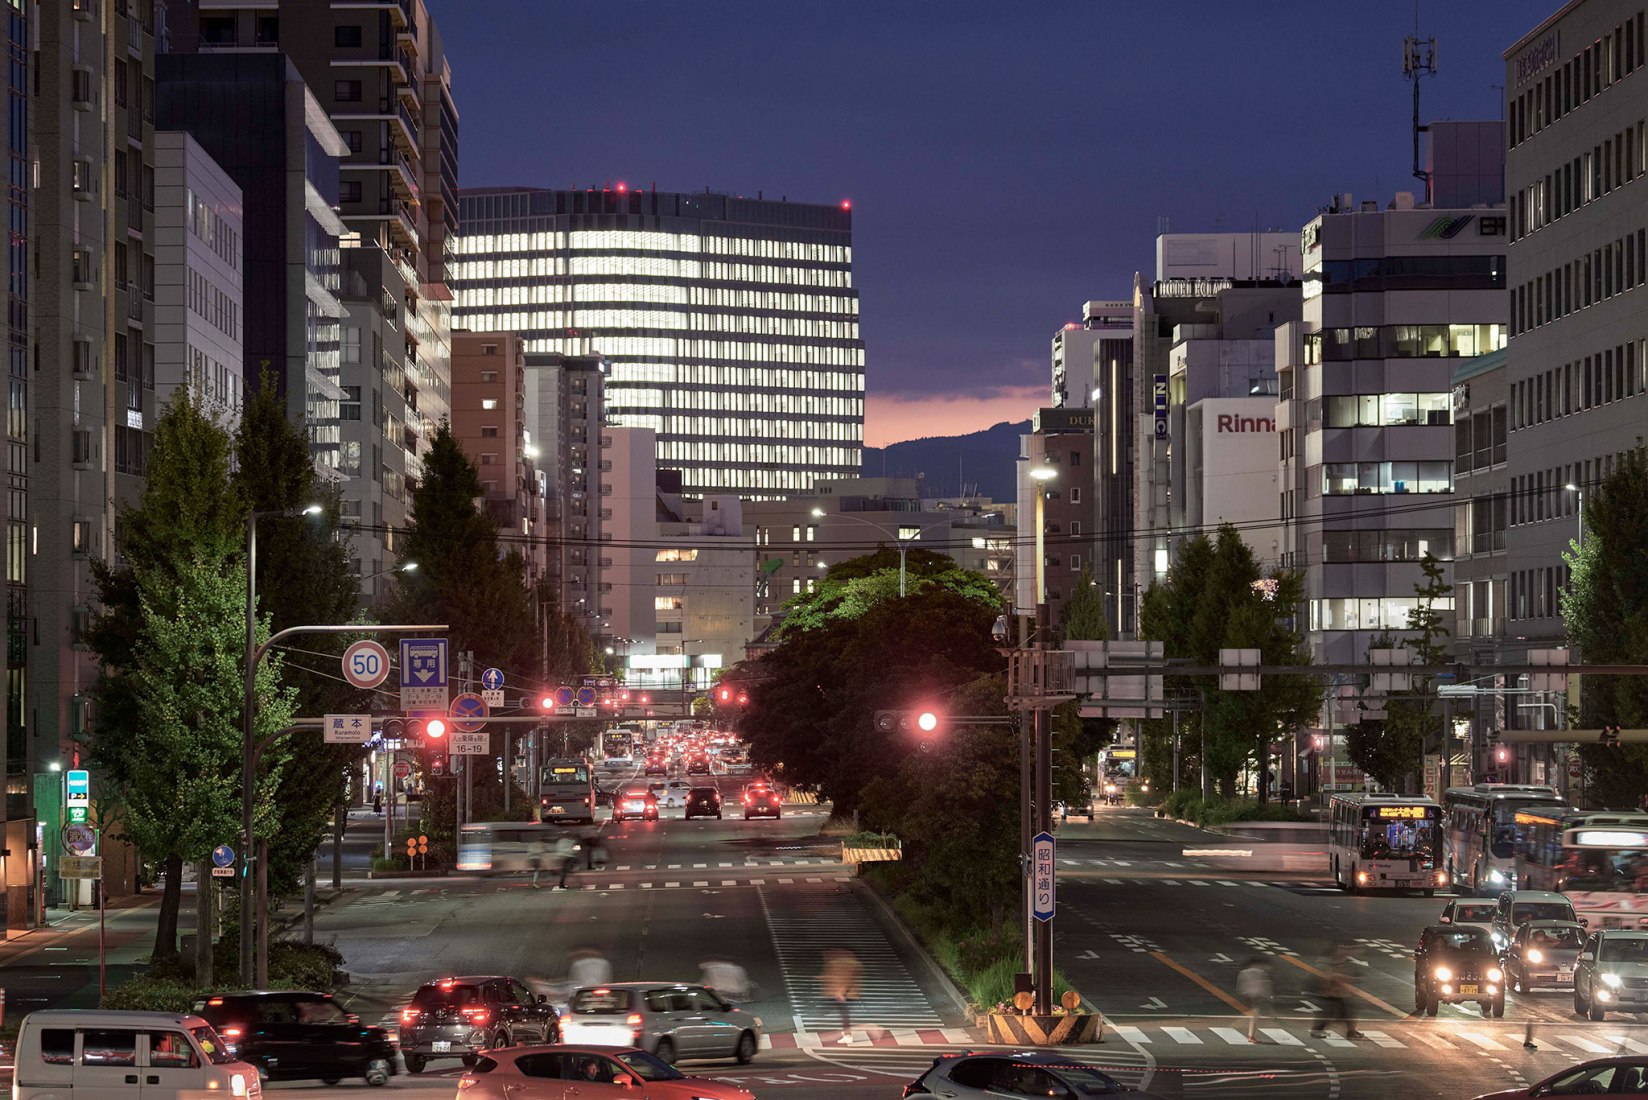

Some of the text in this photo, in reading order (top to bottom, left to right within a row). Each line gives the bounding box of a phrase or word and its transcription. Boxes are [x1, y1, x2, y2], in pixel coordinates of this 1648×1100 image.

[1159, 279, 1191, 298] HOTEL
[353, 654, 379, 675] 50
[413, 658, 436, 668] 専用
[333, 718, 362, 729] 蔵本
[456, 745, 483, 753] 16-19
[69, 830, 94, 842] 消火栓
[1038, 848, 1051, 905] 昭和通り
